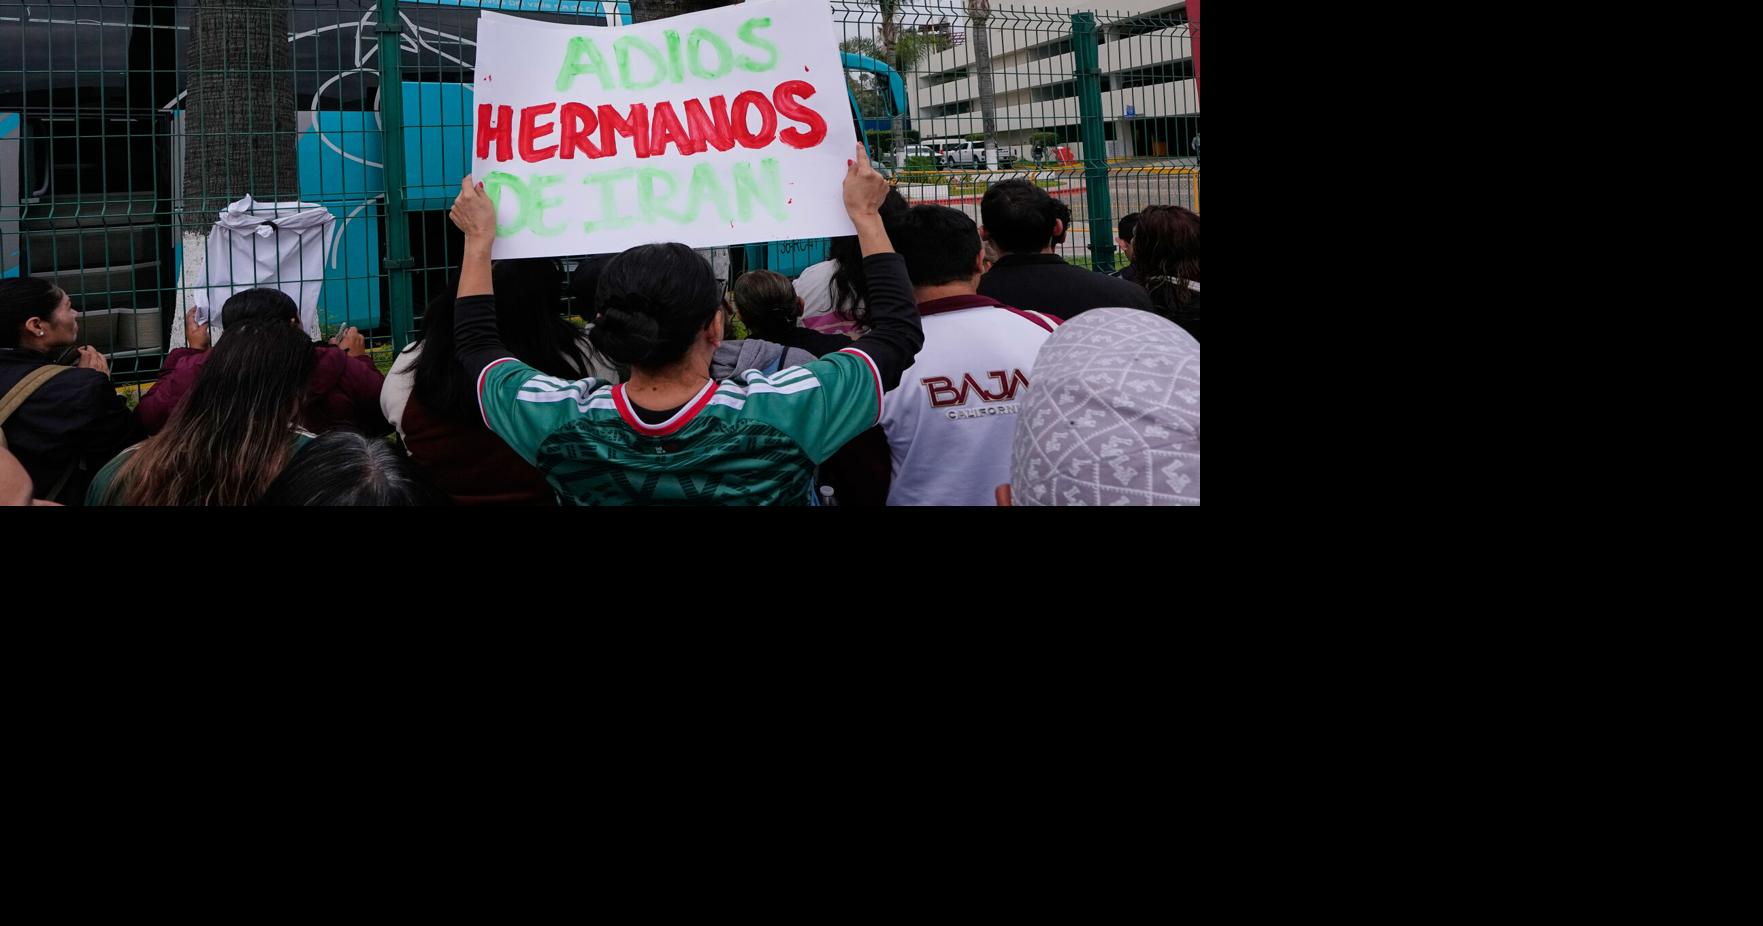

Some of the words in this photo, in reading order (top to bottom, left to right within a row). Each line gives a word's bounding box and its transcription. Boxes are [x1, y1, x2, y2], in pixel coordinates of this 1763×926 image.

[555, 16, 780, 93] ADIOS
[475, 79, 828, 163] HERMANOS
[482, 169, 567, 238] DE
[582, 156, 788, 234] IRAN
[920, 368, 1031, 408] BAJA
